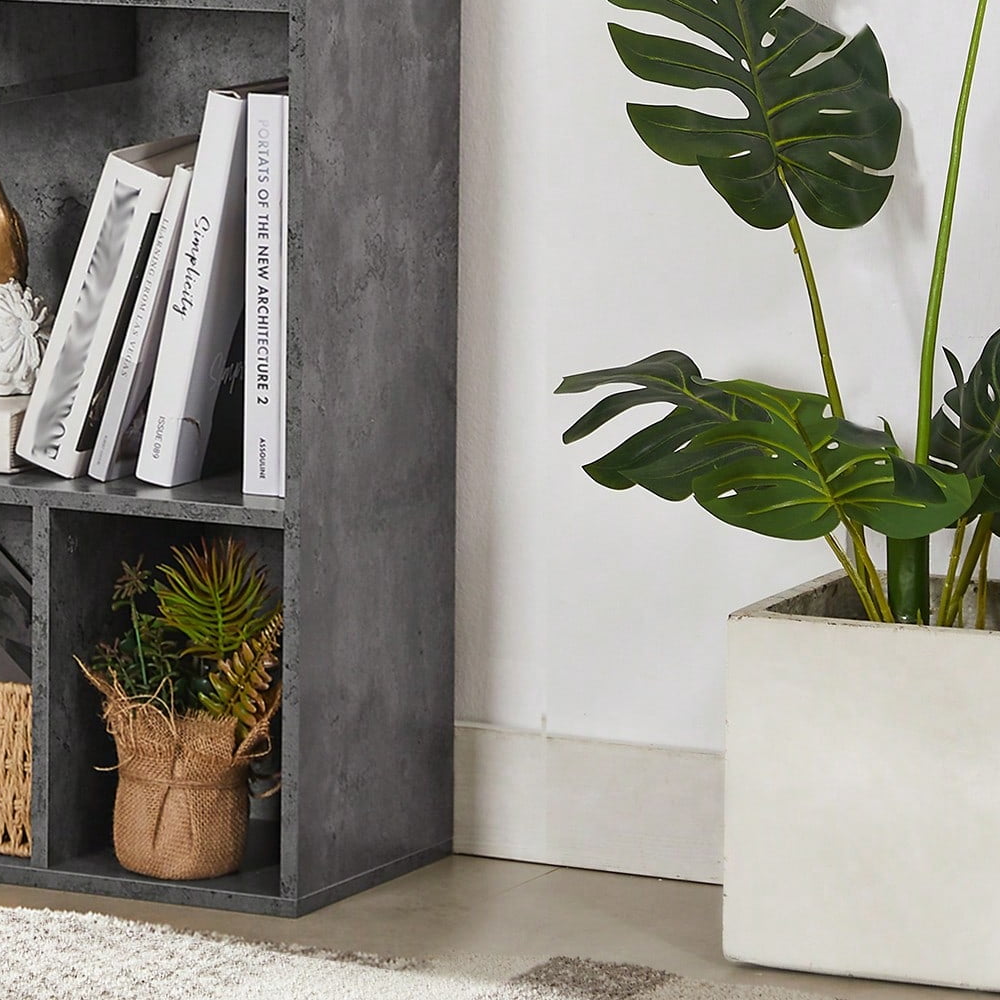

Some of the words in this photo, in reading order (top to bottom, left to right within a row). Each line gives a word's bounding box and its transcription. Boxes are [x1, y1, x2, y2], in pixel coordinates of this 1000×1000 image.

[258, 188, 270, 208] OF
[258, 214, 270, 240] THE
[171, 215, 211, 321] Simplicity
[257, 245, 270, 280] NEW
[139, 280, 153, 312] FROM
[257, 285, 270, 391] ARCHITECTURE
[257, 396, 270, 405] 2
[153, 416, 165, 441] ISSUE
[259, 437, 267, 479] ASSOULINE
